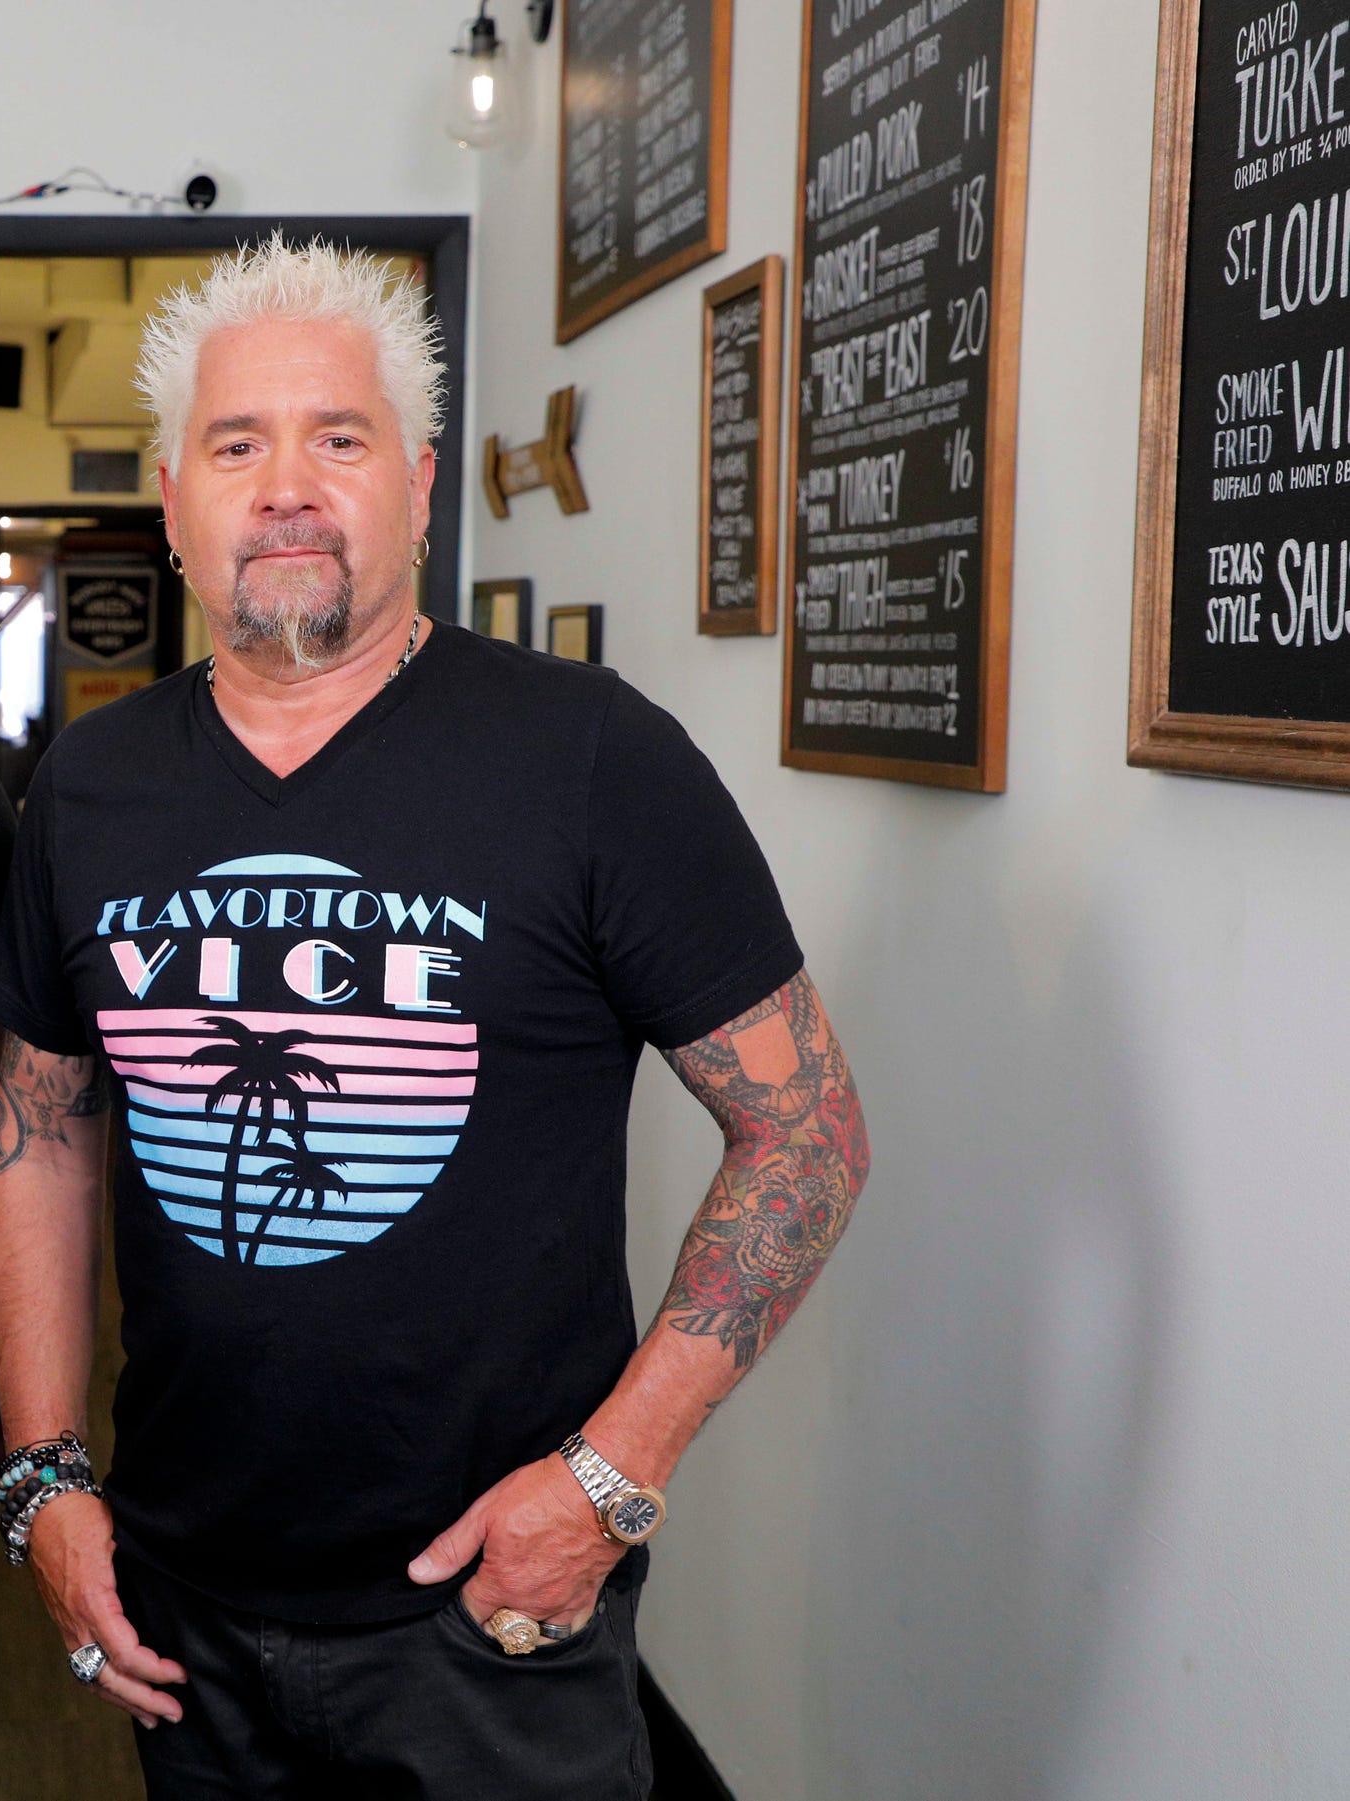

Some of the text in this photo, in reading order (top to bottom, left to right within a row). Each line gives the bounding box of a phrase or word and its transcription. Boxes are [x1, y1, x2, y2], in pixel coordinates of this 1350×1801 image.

[1236, 0, 1298, 66] CARVED
[957, 54, 991, 140] $14
[816, 131, 873, 219] PULLED
[876, 100, 923, 191] PORK
[1234, 158, 1268, 190] ORDER
[1272, 148, 1287, 177] BY
[1290, 138, 1312, 168] THE
[1336, 124, 1350, 150] PO
[952, 174, 986, 267] $18
[1224, 219, 1257, 286] ST.
[812, 225, 880, 321] BRISKET
[947, 286, 988, 363] $20
[822, 334, 867, 418] BEAST
[885, 309, 932, 399] EAST
[1216, 346, 1350, 453] SMOKE WI
[944, 426, 974, 493] $16
[1212, 473, 1262, 501] BUFFALO
[1269, 469, 1284, 493] OR
[1290, 463, 1331, 490] HONEY
[1214, 423, 1273, 469] FRIED
[838, 449, 906, 529] TURKEY
[838, 555, 888, 632] THIGH
[938, 550, 969, 610] $15
[1206, 592, 1261, 644] STYLE
[1208, 538, 1350, 647] TEXAS SAU
[96, 887, 486, 942] FLAVORTOWN
[109, 936, 463, 1014] VICE
